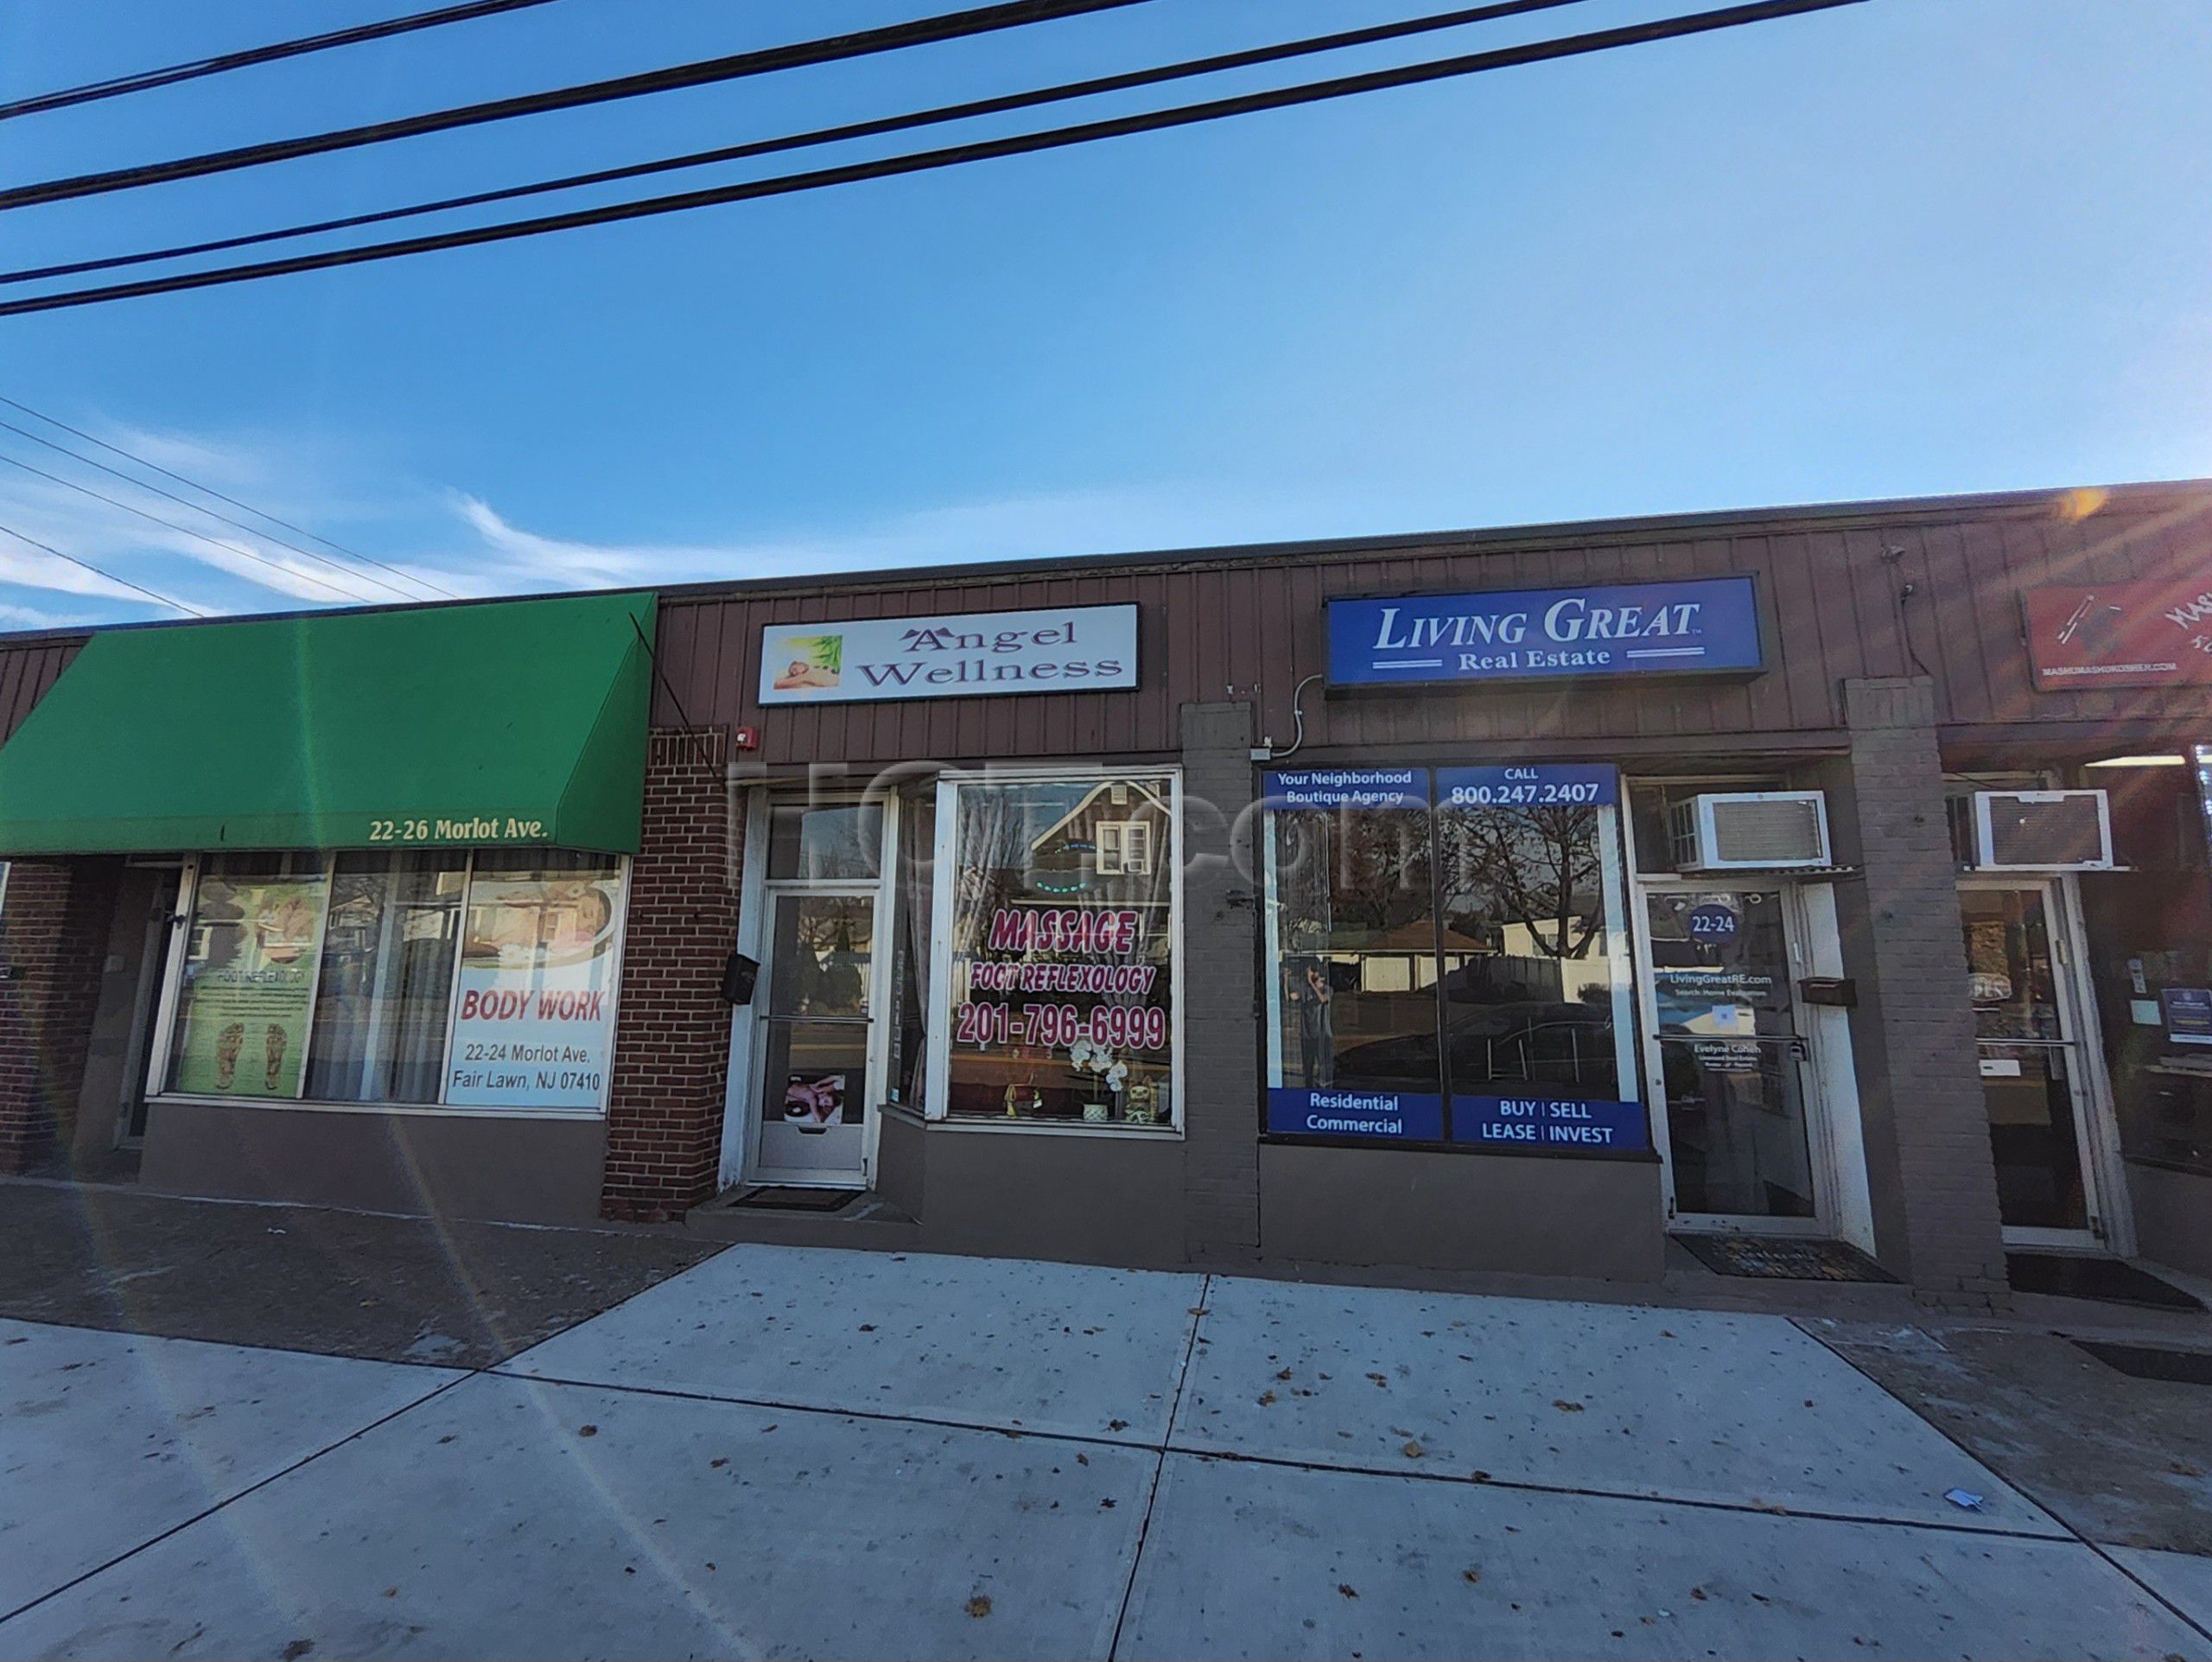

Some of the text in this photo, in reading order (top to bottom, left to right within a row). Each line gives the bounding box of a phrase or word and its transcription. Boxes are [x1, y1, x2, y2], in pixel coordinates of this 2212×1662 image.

[1372, 607, 1528, 650] LIVING
[1544, 597, 1701, 642] GREAT
[900, 621, 1077, 653] Angel
[1458, 648, 1611, 672] Real Estate
[855, 659, 1122, 687] Wellness
[1277, 769, 1412, 787] Your Neighborhood
[1503, 767, 1539, 780] CALL
[1286, 790, 1404, 806] Boutique Agency
[1451, 783, 1599, 806] 800.247.2407
[369, 817, 548, 841] 22-26 Morlot Ave.
[988, 909, 1138, 954] MASSAGE
[1691, 915, 1735, 933] 22-24
[1020, 963, 1157, 994] REFLEXOLOGY
[1669, 973, 1772, 986] LivingGreatRE.com
[461, 990, 605, 1022] BODY WORK
[957, 1001, 1166, 1050] 201-796-6999
[464, 1043, 591, 1063] 22-24 Morlot Ave.
[452, 1069, 601, 1091] Fair Lawn, NJ 07410
[1309, 1092, 1399, 1111] Residential
[1499, 1099, 1592, 1120] BUY SELL
[1306, 1114, 1403, 1135] Commercial
[1482, 1122, 1613, 1143] LEASE INVEST
